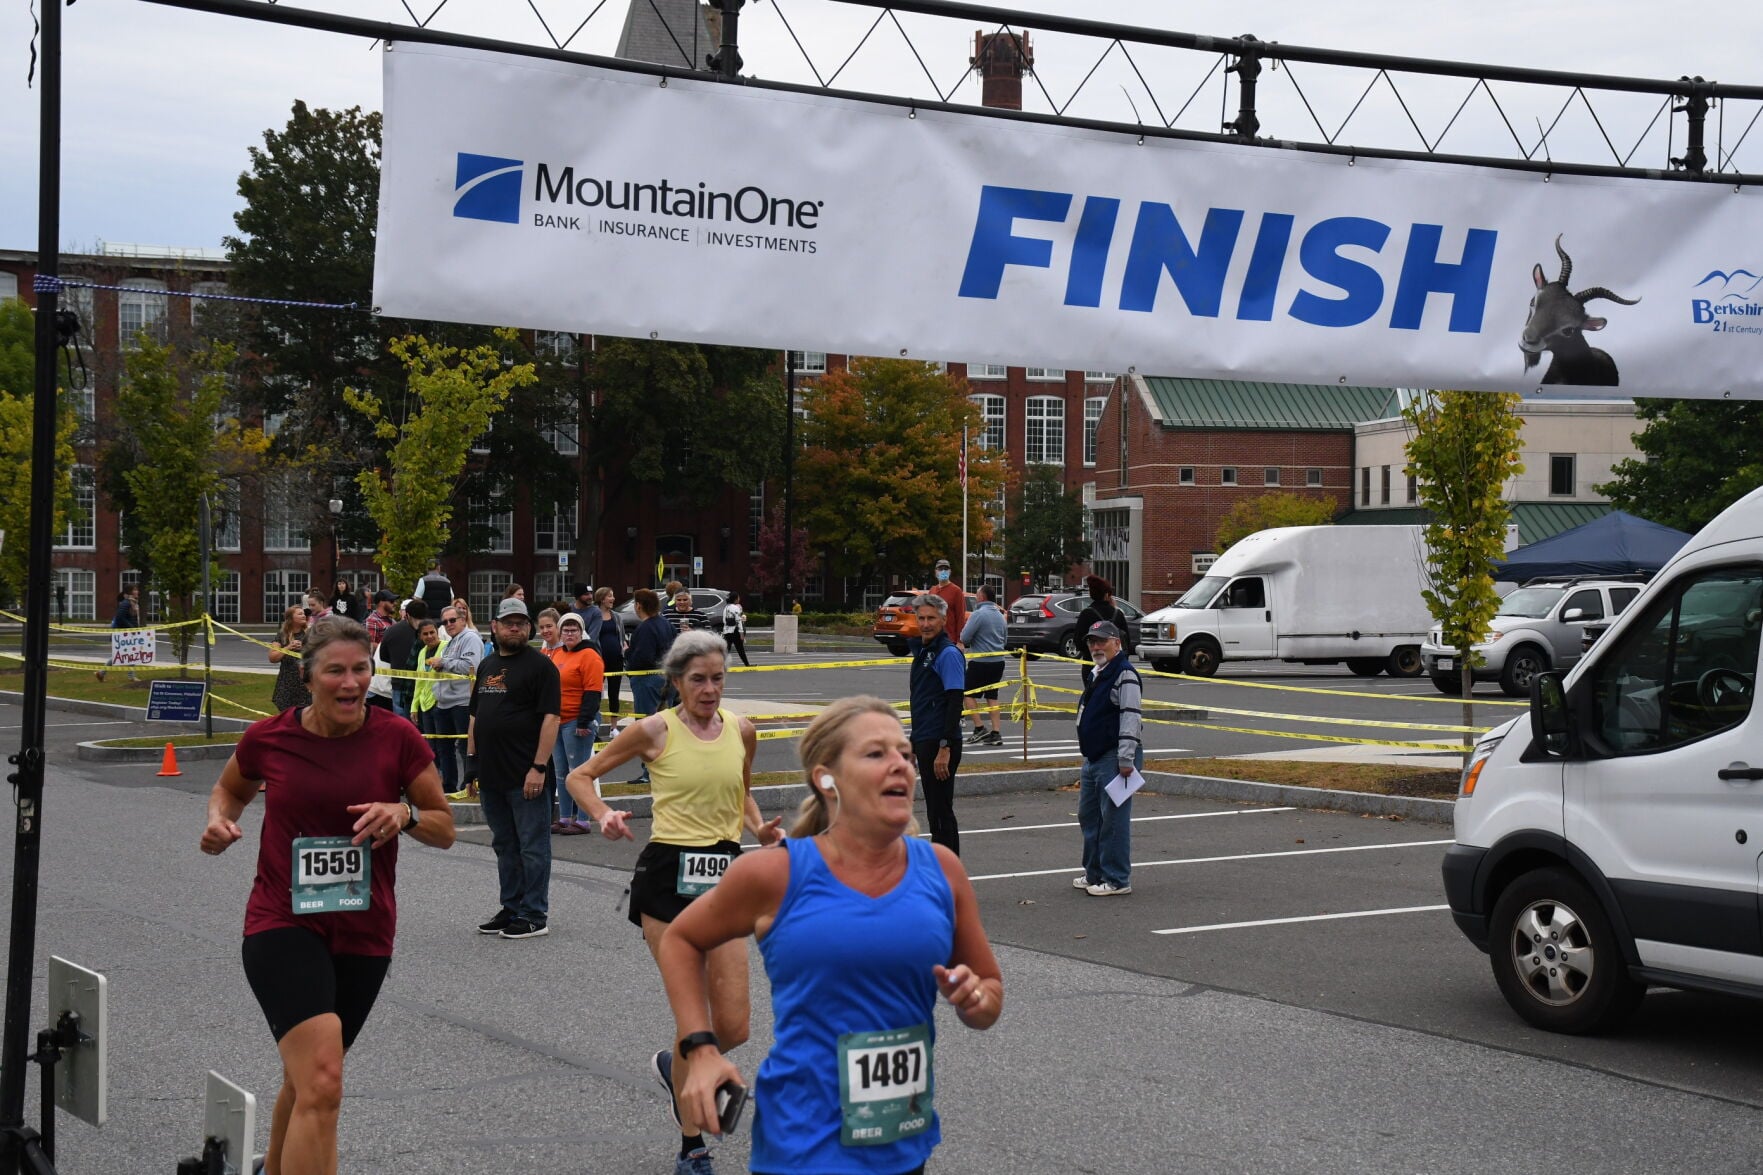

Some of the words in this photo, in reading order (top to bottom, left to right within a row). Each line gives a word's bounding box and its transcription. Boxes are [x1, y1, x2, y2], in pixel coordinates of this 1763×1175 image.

[535, 163, 820, 229] MountainOne
[534, 213, 580, 230] BANK
[599, 219, 690, 242] INSURANCE
[707, 231, 817, 254] INVESTMENTS
[958, 185, 1498, 333] FINISH
[301, 850, 360, 876] 1559
[687, 856, 729, 877] 1499
[300, 900, 324, 909] BEER
[339, 898, 363, 906] FOOD
[855, 1046, 921, 1089] 1487
[852, 1126, 883, 1139] BEER
[899, 1117, 925, 1132] FOOD
